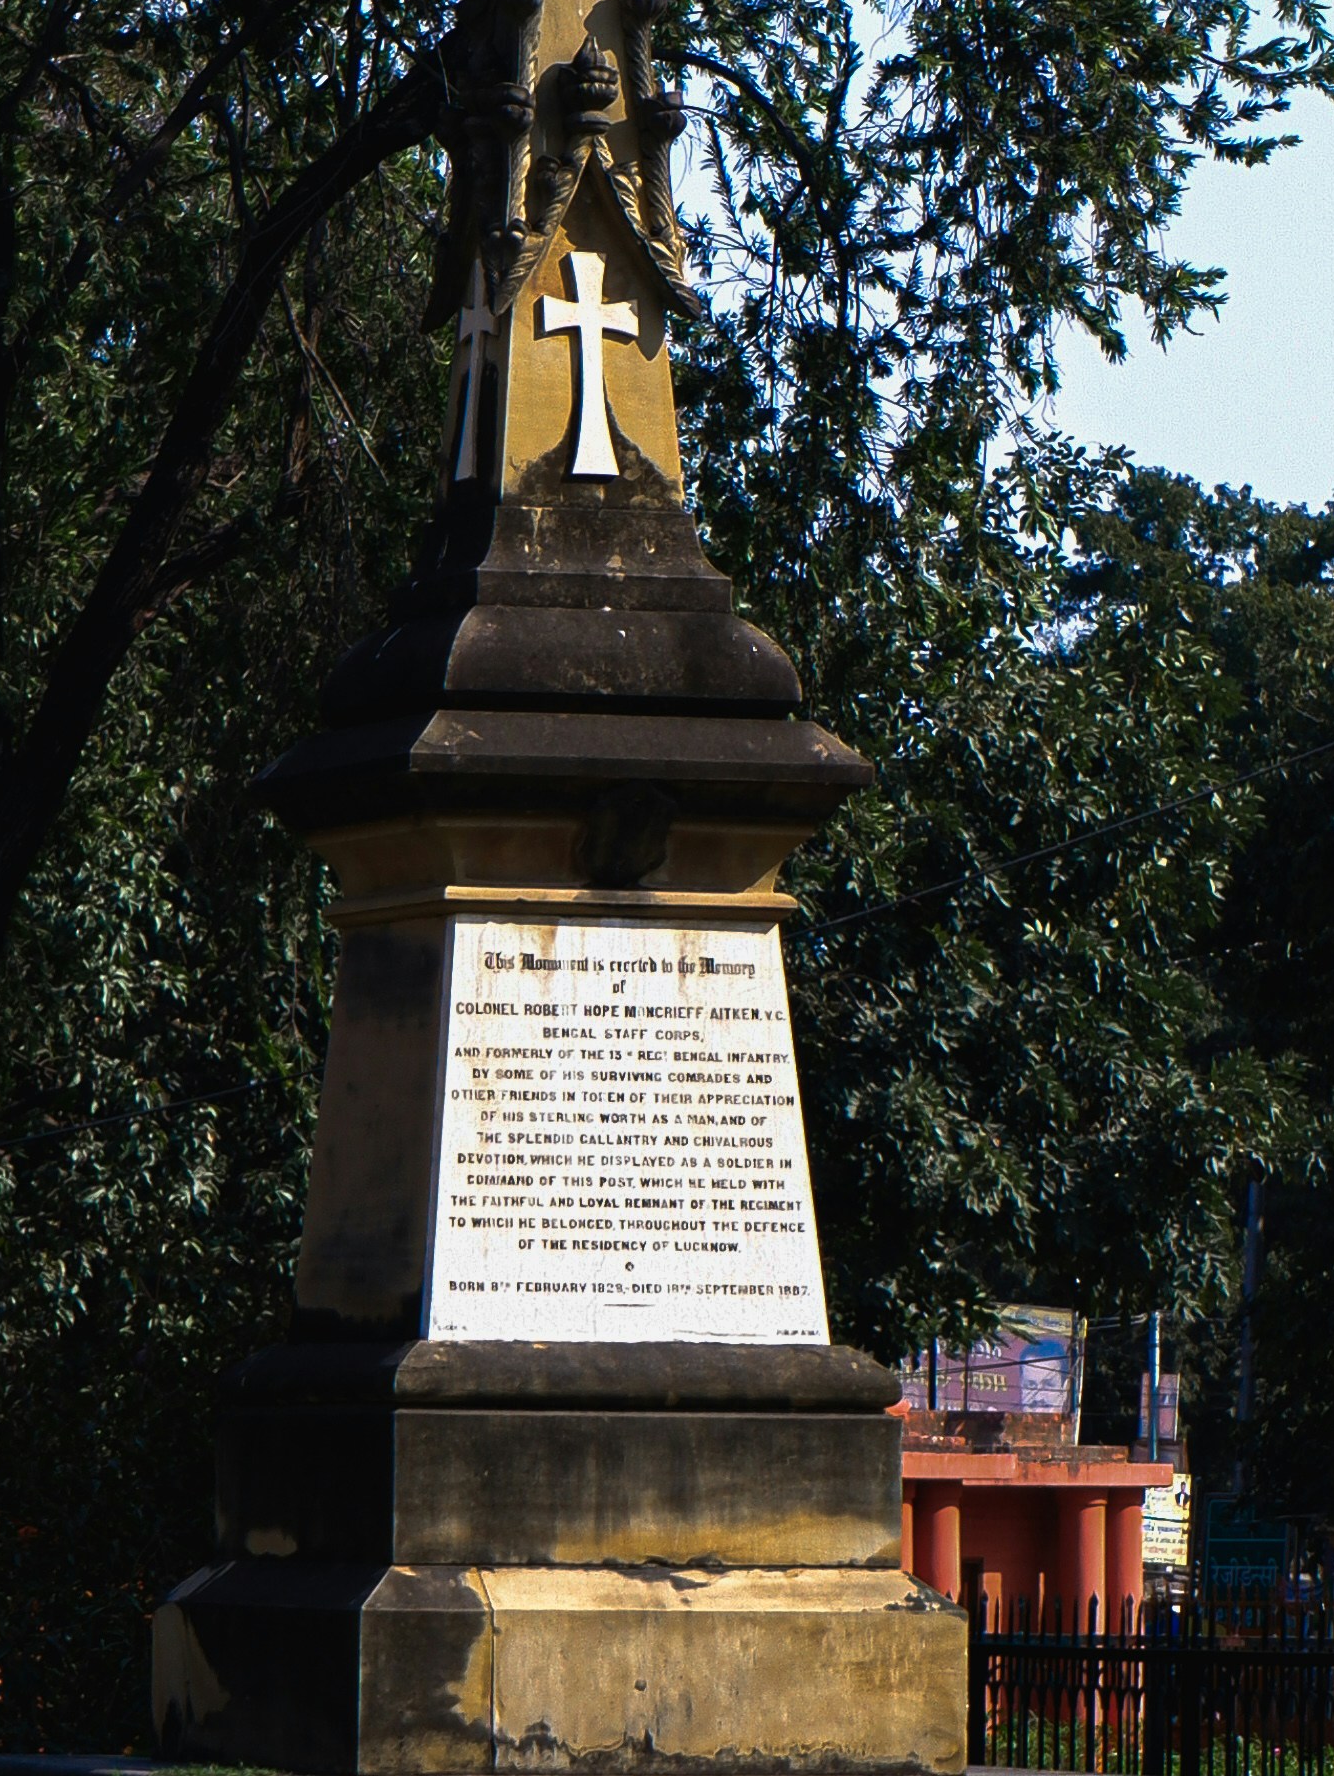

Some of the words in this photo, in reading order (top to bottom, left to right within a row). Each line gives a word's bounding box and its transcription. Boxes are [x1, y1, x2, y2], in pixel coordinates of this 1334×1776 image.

[483, 952, 515, 971] This
[520, 953, 589, 972] Monument
[593, 957, 604, 972] is
[609, 957, 657, 972] erected
[661, 958, 673, 973] to
[677, 955, 696, 973] the
[698, 956, 755, 978] Memory
[613, 980, 626, 993] of
[455, 1002, 518, 1015] COLONEL
[583, 1005, 619, 1017] HOPE
[542, 1027, 596, 1039] BENGAL
[604, 1029, 647, 1039] STAFF
[454, 1047, 480, 1058] AND
[484, 1048, 552, 1059] FORMERLY
[557, 1050, 574, 1059] OF
[579, 1050, 604, 1060] THE
[673, 1052, 722, 1062] BENGAL
[471, 1068, 489, 1079] BY
[494, 1069, 533, 1079] SOME
[539, 1070, 556, 1080] OF
[562, 1071, 584, 1080] HIS
[590, 1071, 661, 1081] SURVIVING
[667, 1073, 740, 1083] COMRADES
[746, 1074, 772, 1084] AND
[451, 1089, 495, 1101] OTHER
[501, 1090, 556, 1101] FRIENDS
[563, 1092, 575, 1101] IN
[629, 1093, 646, 1103] OF
[654, 1093, 692, 1104] THEIR
[697, 1094, 794, 1106] APPRECIATION
[480, 1111, 497, 1121] OF
[502, 1112, 524, 1122] HIS
[528, 1112, 593, 1122] STERLING
[599, 1113, 645, 1123] WORTH
[651, 1114, 668, 1124] AS
[675, 1115, 682, 1124] A
[718, 1116, 745, 1125] AND
[750, 1116, 767, 1126] OF
[476, 1132, 502, 1143] THE
[507, 1133, 573, 1144] SPLENDID
[579, 1134, 657, 1145] GALLANTRY
[663, 1136, 688, 1146] AND
[693, 1136, 773, 1148] CHIVALROUS
[529, 1155, 572, 1165] WHICH
[577, 1155, 594, 1166] HE
[600, 1156, 675, 1167] DISPLAYED
[680, 1158, 697, 1167] AS
[703, 1158, 711, 1167] A
[716, 1158, 773, 1169] SOLDIER
[780, 1159, 792, 1168] IN
[466, 1175, 533, 1186] COMMAND
[538, 1176, 556, 1186] OF
[562, 1177, 593, 1186] THIS
[639, 1178, 682, 1188] WHICH
[688, 1179, 705, 1188] HE
[711, 1179, 746, 1189] HELD
[751, 1180, 784, 1189] WITH
[450, 1195, 476, 1206] THE
[482, 1196, 543, 1207] FAITHFUL
[549, 1197, 574, 1207] AND
[578, 1198, 619, 1208] LOYAL
[624, 1198, 684, 1209] REMNANT
[691, 1200, 705, 1209] OF
[711, 1199, 735, 1210] THE
[739, 1200, 801, 1211] REGIMENT
[448, 1217, 466, 1227] TO
[470, 1218, 513, 1228] WHICH
[518, 1218, 535, 1228] HE
[618, 1220, 705, 1231] THROUGHOUT
[712, 1222, 738, 1231] THE
[743, 1222, 805, 1232] DEFENCE
[518, 1239, 535, 1249] OF
[541, 1239, 567, 1250] THE
[571, 1240, 646, 1251] RESIDENCY
[652, 1241, 669, 1251] OF
[448, 1281, 484, 1291] BORN
[516, 1282, 586, 1292] FEBRUARY
[695, 1284, 773, 1295] SEPTEMBER
